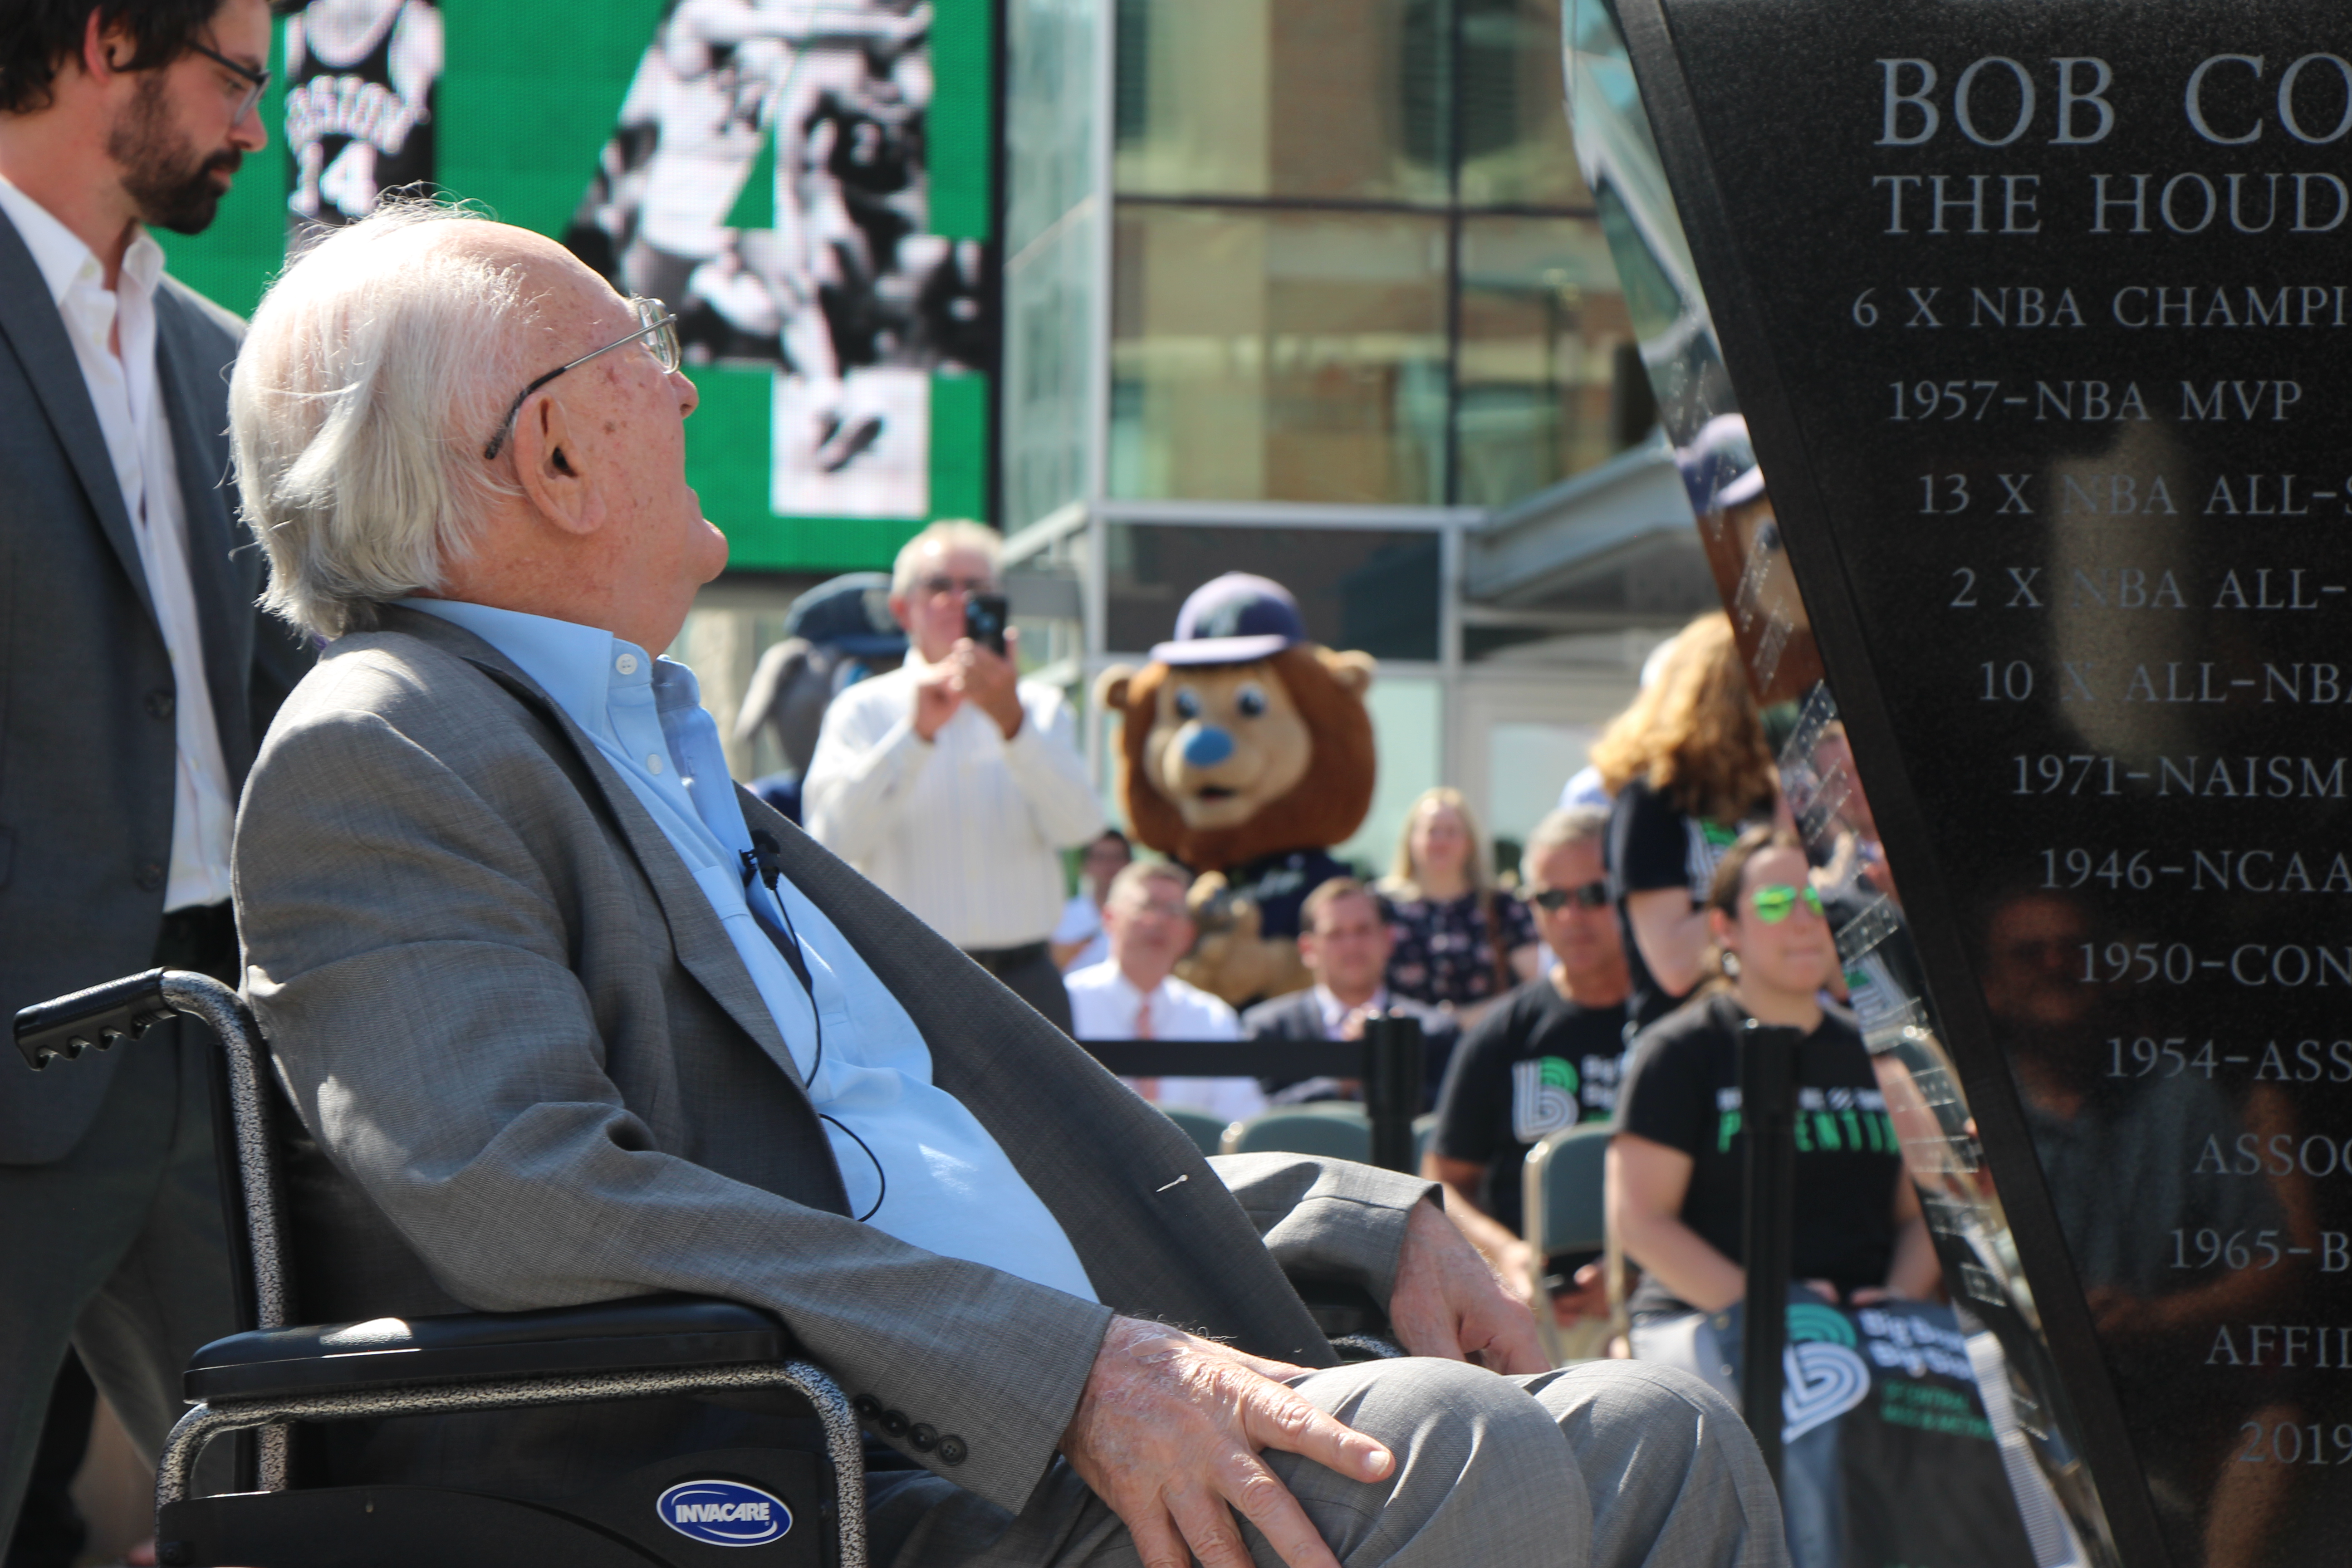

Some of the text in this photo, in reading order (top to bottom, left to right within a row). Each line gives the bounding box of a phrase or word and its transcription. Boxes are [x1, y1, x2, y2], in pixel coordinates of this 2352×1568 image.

[1873, 52, 2352, 147] BOB CO
[1872, 172, 2350, 235] THE HOUD
[1852, 285, 2347, 328] 6 X NBA CHAMPI
[1889, 380, 2303, 422] 1957-NBA MVP
[1919, 473, 2352, 515] 13 X NBA ALL-
[1950, 567, 2347, 610] 2 X NBA ALL-
[1980, 661, 2352, 704] 10 X ALL-NB
[2013, 755, 2347, 799] 1971-NAISM
[2040, 848, 2352, 893] 1946-NCAA
[2080, 942, 2352, 986] 1950-CON
[2107, 1037, 2352, 1082] 1954-ASS
[2195, 1134, 2352, 1177] ASSO
[2170, 1229, 2351, 1272] 1965-B
[2238, 1421, 2352, 1465] 2019
[675, 1502, 770, 1523] INVACARE
